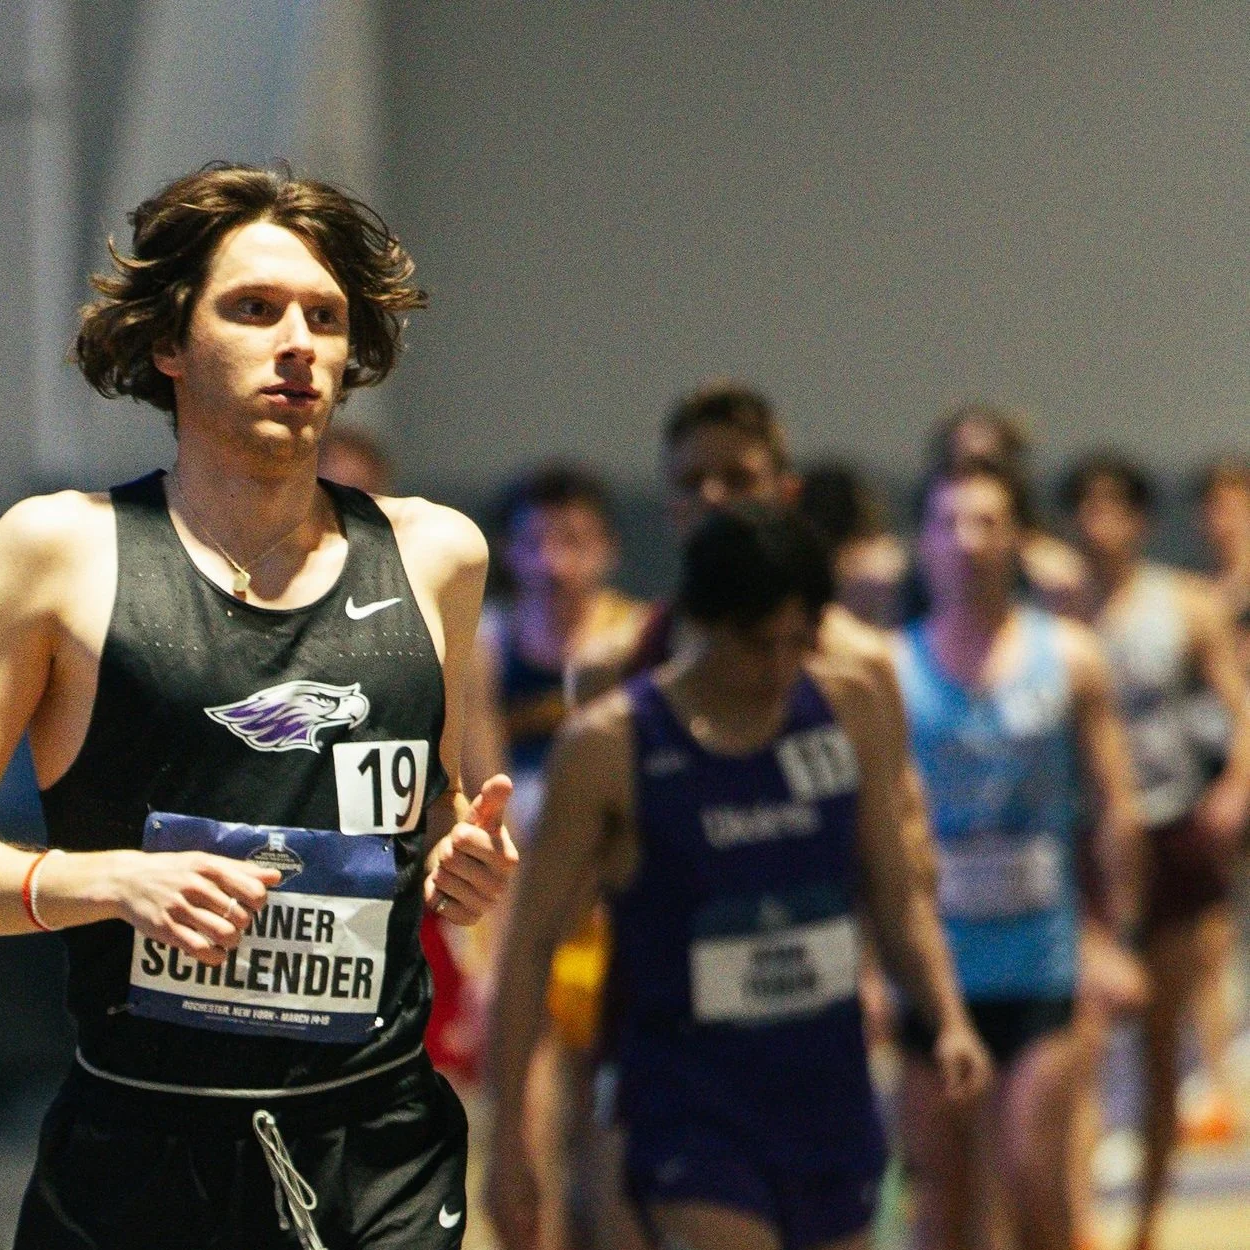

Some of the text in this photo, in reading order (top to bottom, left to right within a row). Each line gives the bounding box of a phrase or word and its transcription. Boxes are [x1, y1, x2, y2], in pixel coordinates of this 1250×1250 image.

[357, 747, 417, 828] 19
[245, 904, 336, 943] NNER
[232, 1007, 251, 1018] NEW
